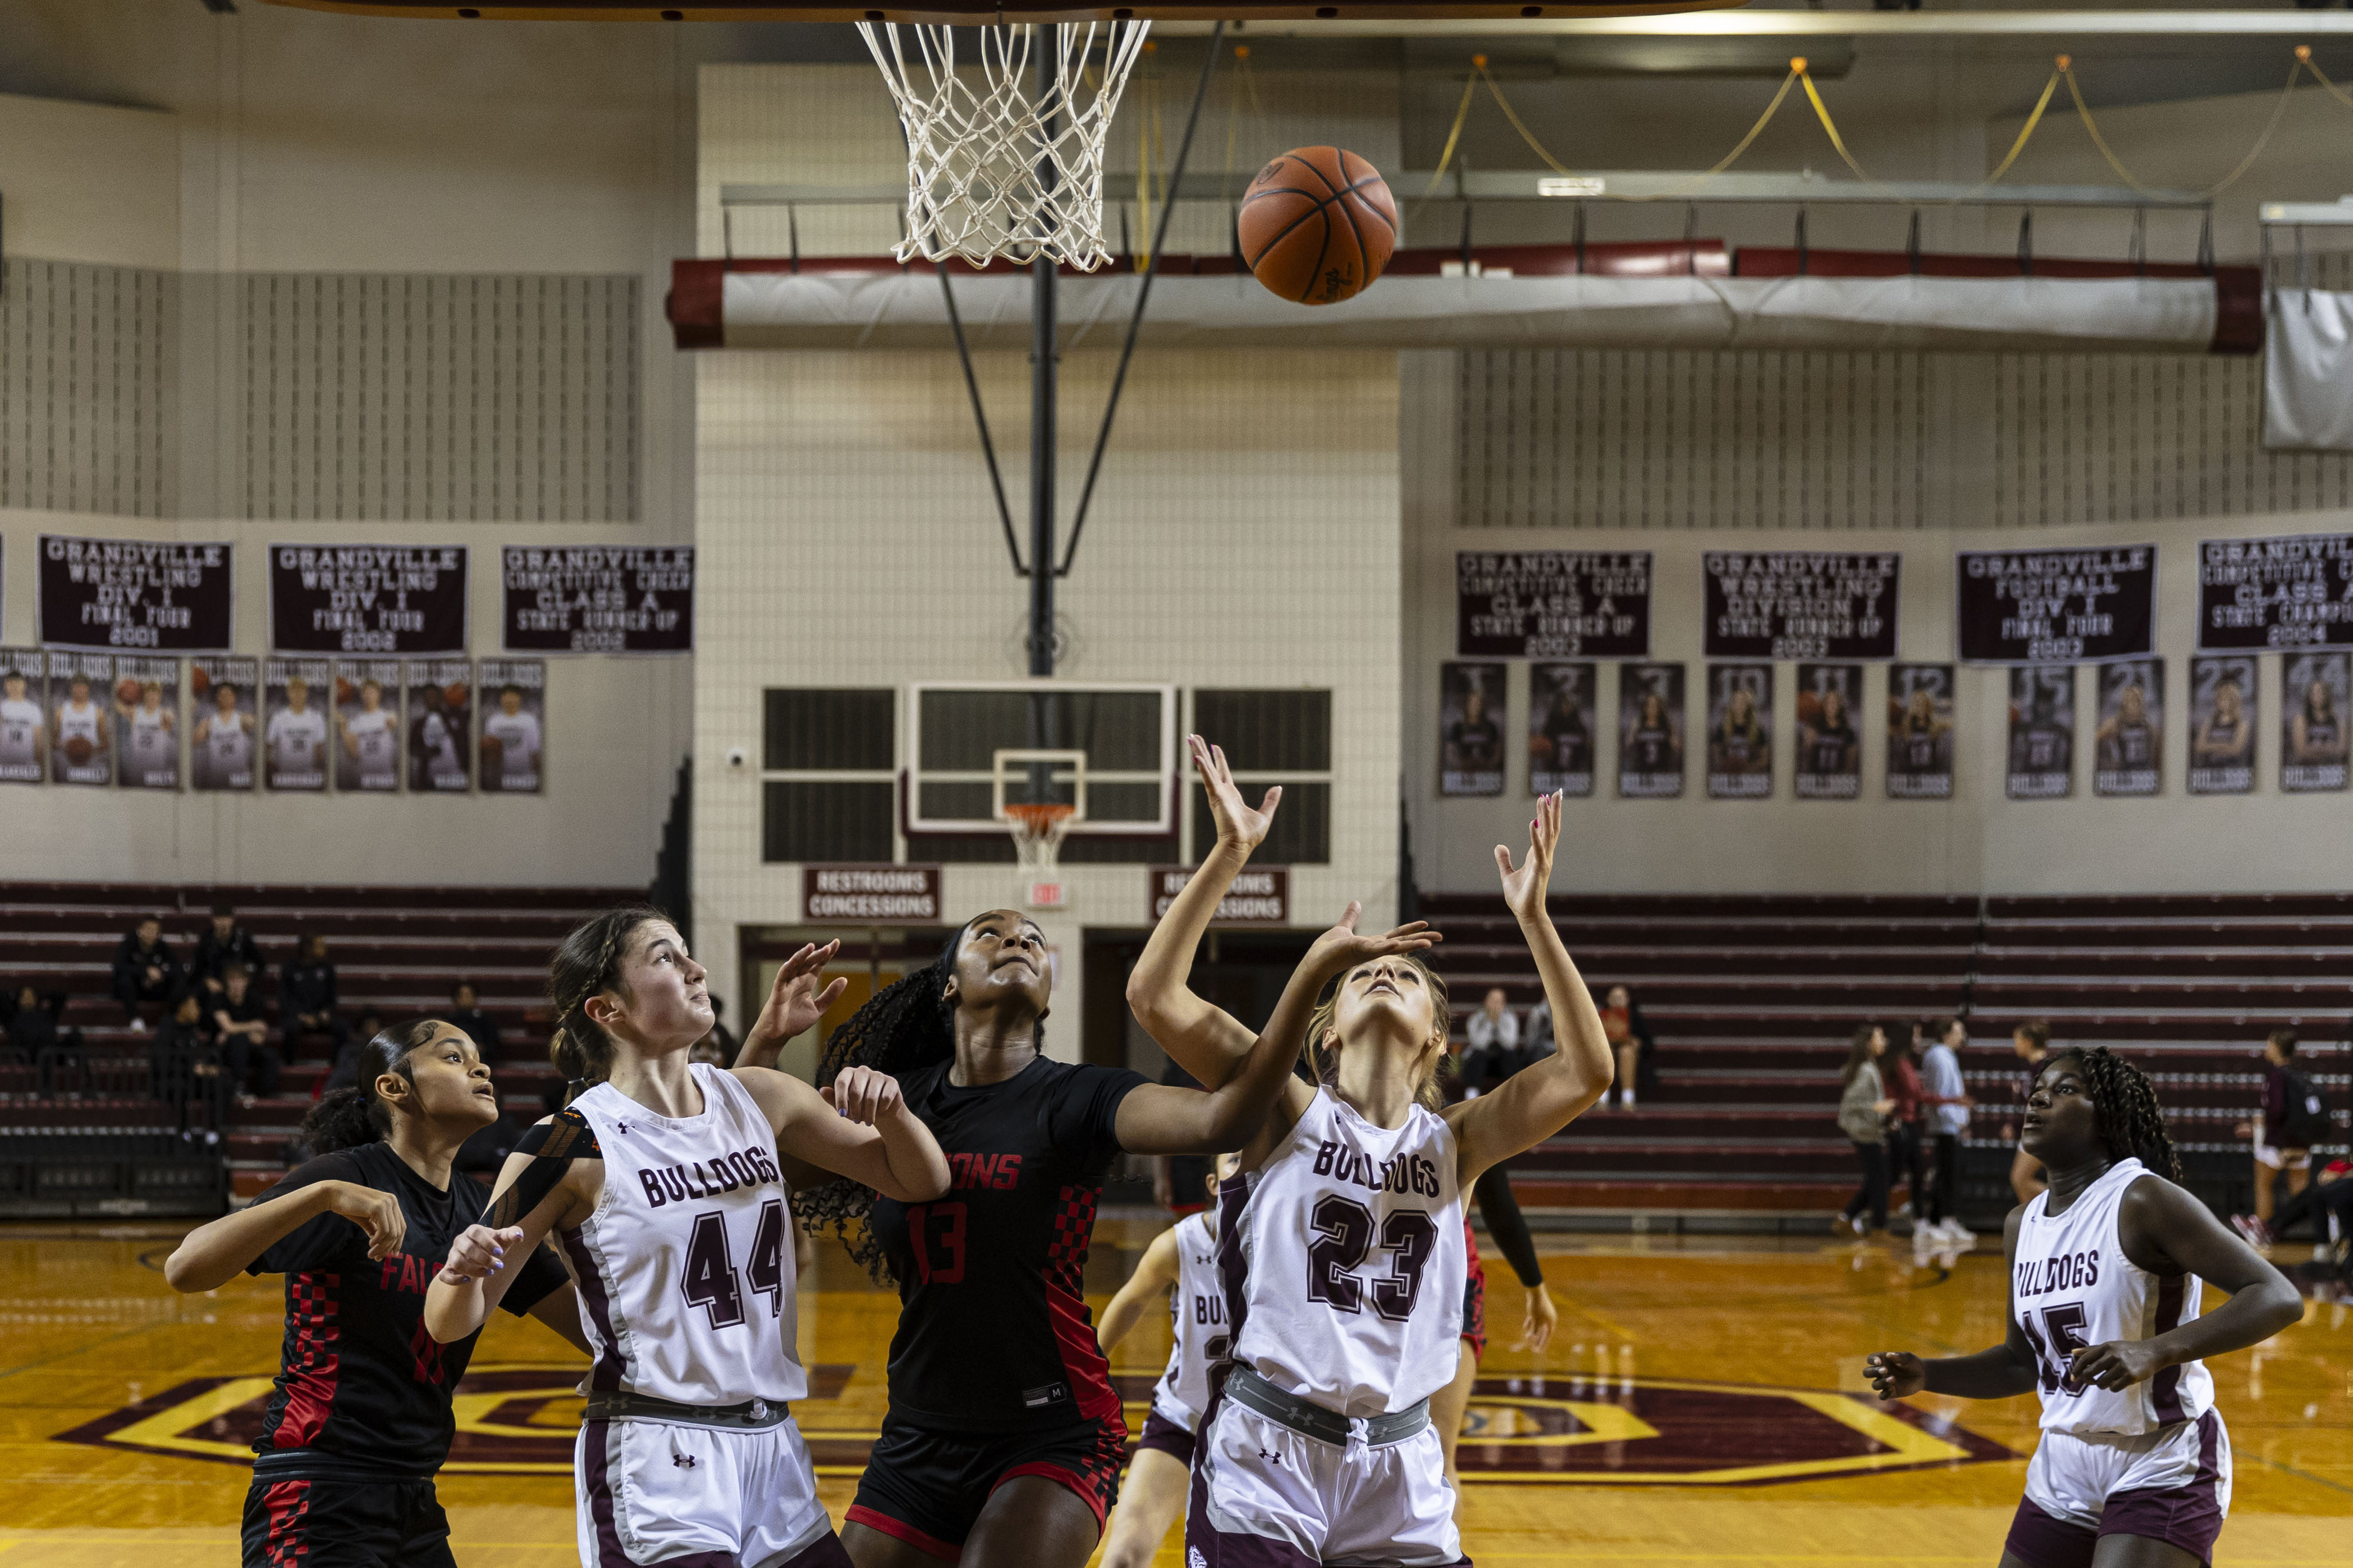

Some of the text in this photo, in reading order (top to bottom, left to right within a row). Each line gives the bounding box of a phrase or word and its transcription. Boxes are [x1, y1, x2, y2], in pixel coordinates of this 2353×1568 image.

[47, 539, 222, 567] GRANDVILLE
[280, 549, 458, 570] GRANDVILLE
[507, 549, 690, 571] GRANDVILLE
[1968, 550, 2148, 578] GRANDVILLE
[68, 562, 202, 588] WRESTLING
[1462, 555, 1645, 576] GRANDVILLE
[1708, 554, 1893, 577] GRANDVILLE
[301, 570, 437, 591] WRESTLING
[507, 570, 624, 591] COMPETITIVE
[1720, 576, 1884, 599] WRESTLING
[1996, 574, 2119, 599] FOOTBALL
[537, 590, 659, 612] CLASS A
[1491, 595, 1616, 616] CLASS A
[2235, 582, 2327, 607] CLASS
[82, 602, 135, 627] FINAL
[1726, 597, 1853, 617] DIVISION
[2212, 605, 2266, 628] STATE
[313, 609, 366, 631] FINAL
[517, 609, 571, 631] STATE
[1470, 615, 1524, 637] STATE
[1718, 616, 1772, 638] STATE
[2002, 617, 2054, 640] FINAL
[817, 872, 927, 893] RESTROOMS
[809, 894, 935, 917] CONCESSIONS
[638, 1145, 779, 1208] BULLDOGS
[945, 1152, 1022, 1190] ONS
[1312, 1139, 1440, 1198] BULLDOGS
[906, 1202, 967, 1285] 13
[680, 1198, 787, 1330] 44
[1307, 1194, 1439, 1323] 23
[1052, 1388, 1061, 1397] M
